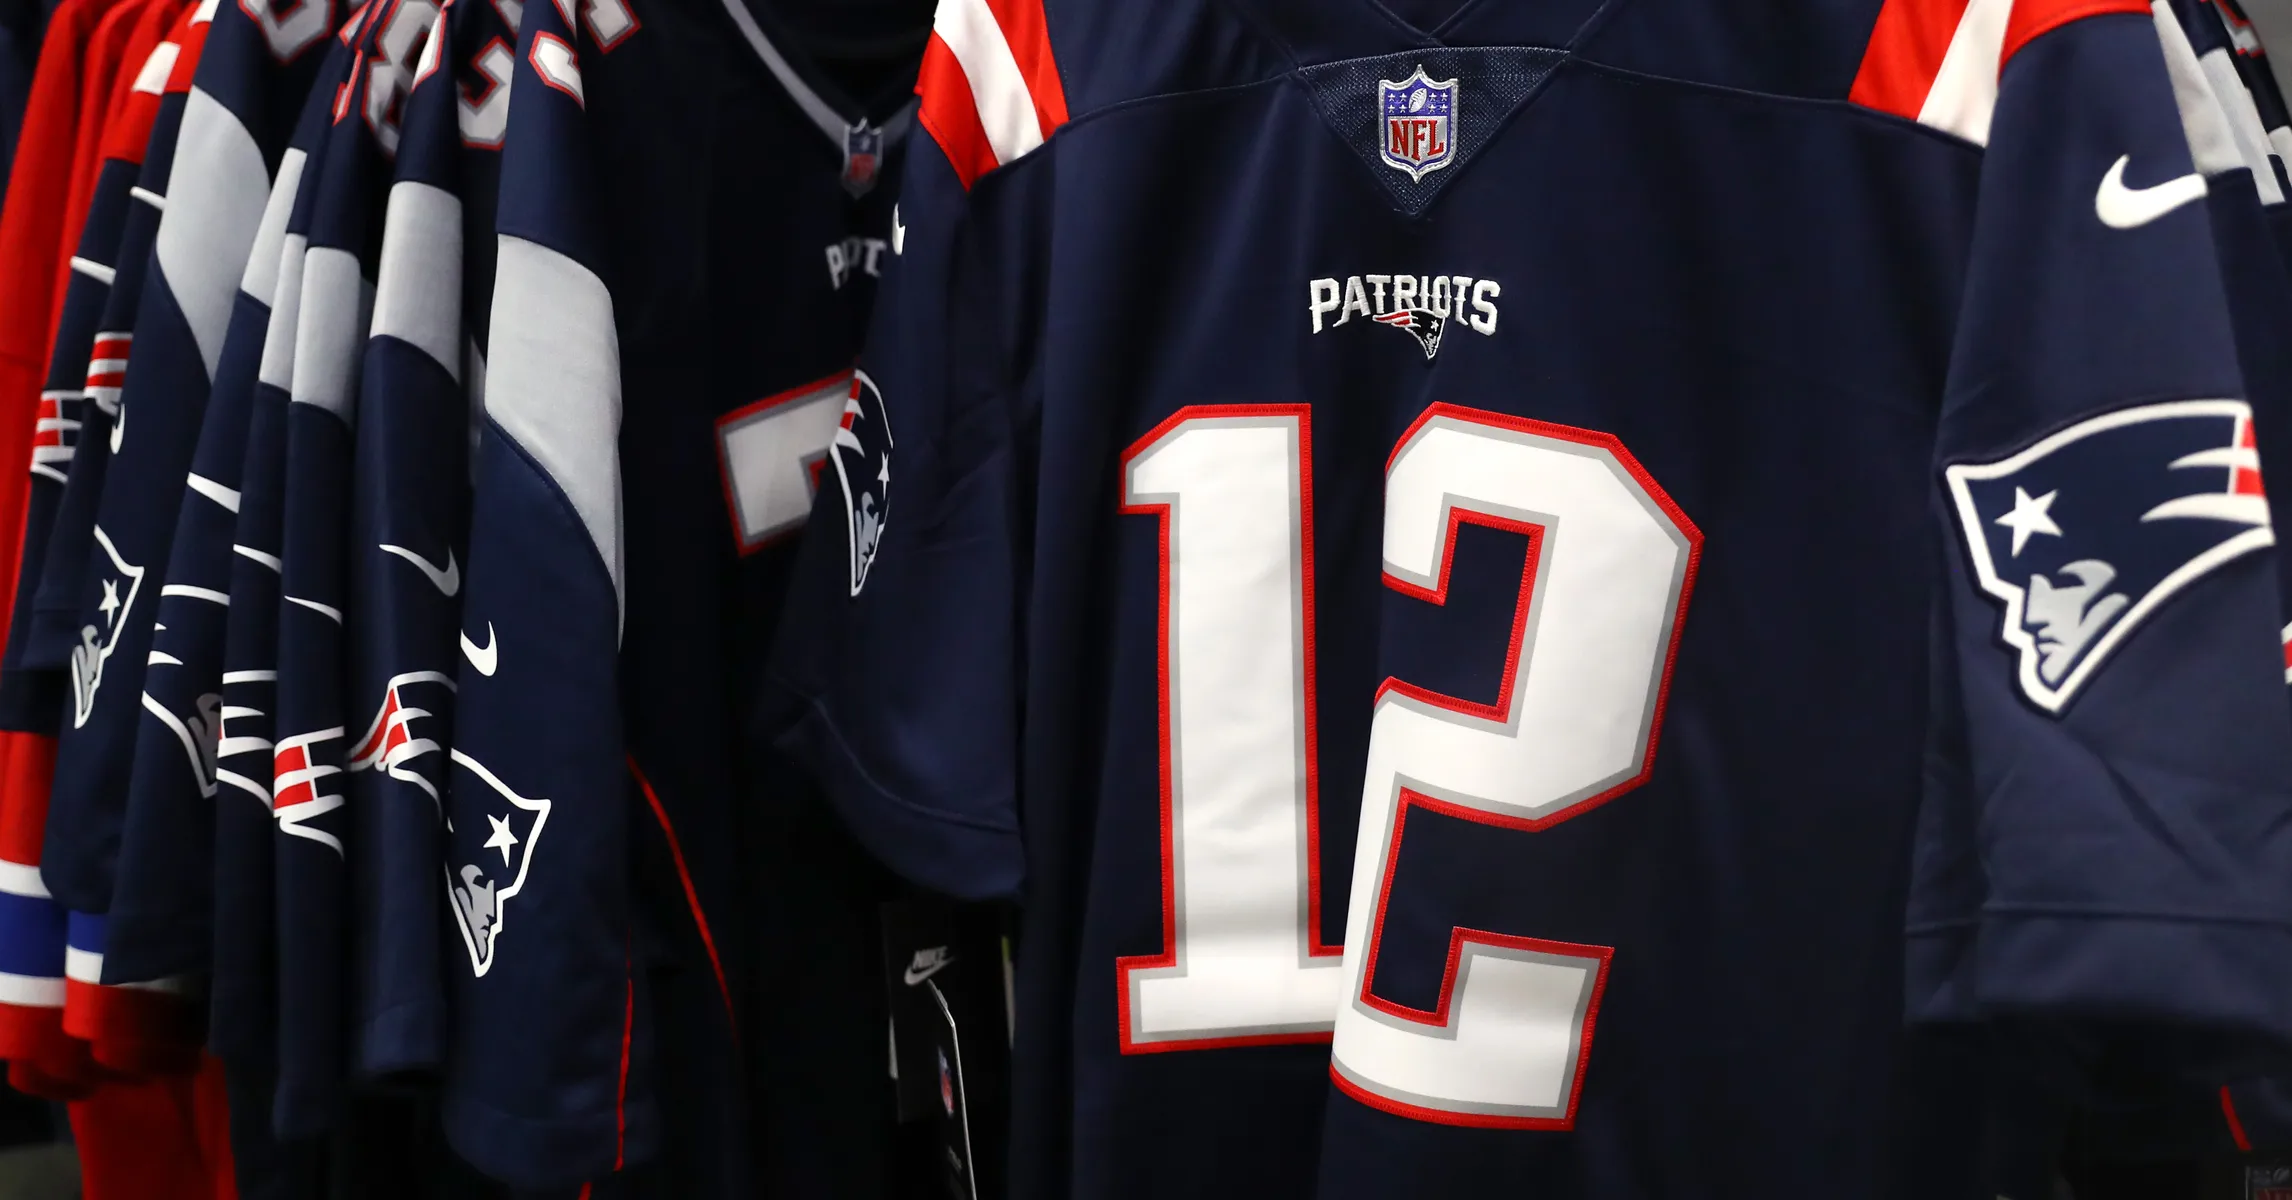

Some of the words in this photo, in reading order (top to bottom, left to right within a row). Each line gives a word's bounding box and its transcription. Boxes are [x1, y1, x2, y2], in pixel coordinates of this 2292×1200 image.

[1390, 119, 1445, 162] NFL
[1308, 274, 1501, 336] PATRIOTS
[1117, 401, 1704, 1131] 12
